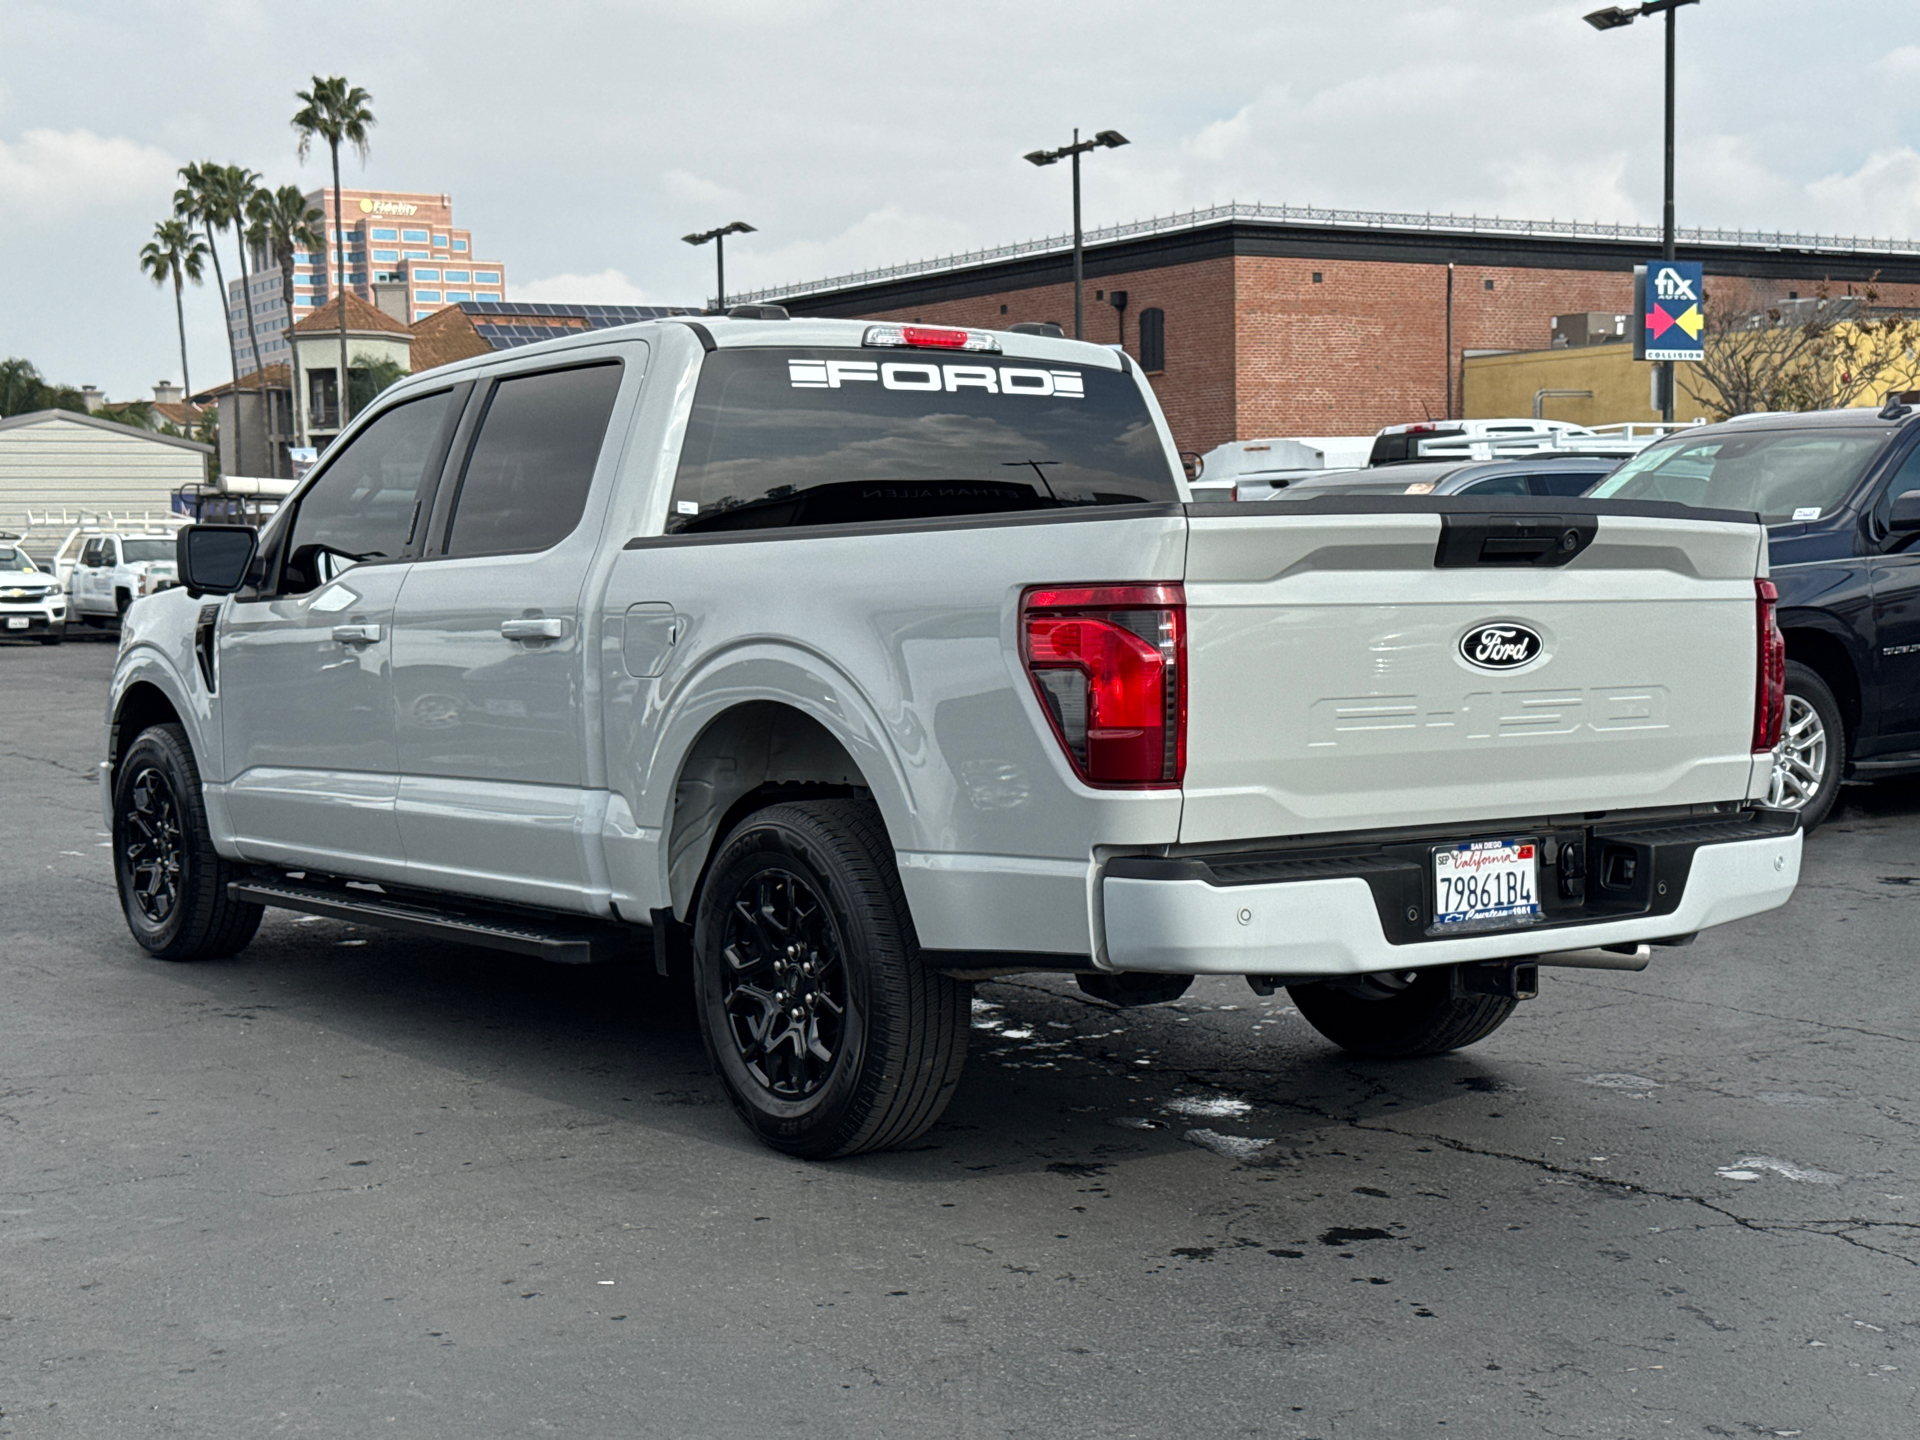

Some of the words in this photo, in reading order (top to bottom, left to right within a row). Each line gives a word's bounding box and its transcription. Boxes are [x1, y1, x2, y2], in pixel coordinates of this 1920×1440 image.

[373, 201, 417, 216] Fidelity
[1654, 267, 1698, 300] fix
[826, 359, 1054, 397] FORD
[1476, 629, 1529, 660] Ford
[1307, 684, 1671, 746] F-150
[1438, 855, 1450, 866] SEP
[1454, 850, 1517, 872] California
[1470, 842, 1483, 850] SAN
[1484, 841, 1502, 849] DIEGO
[1440, 870, 1532, 912] 79861B4
